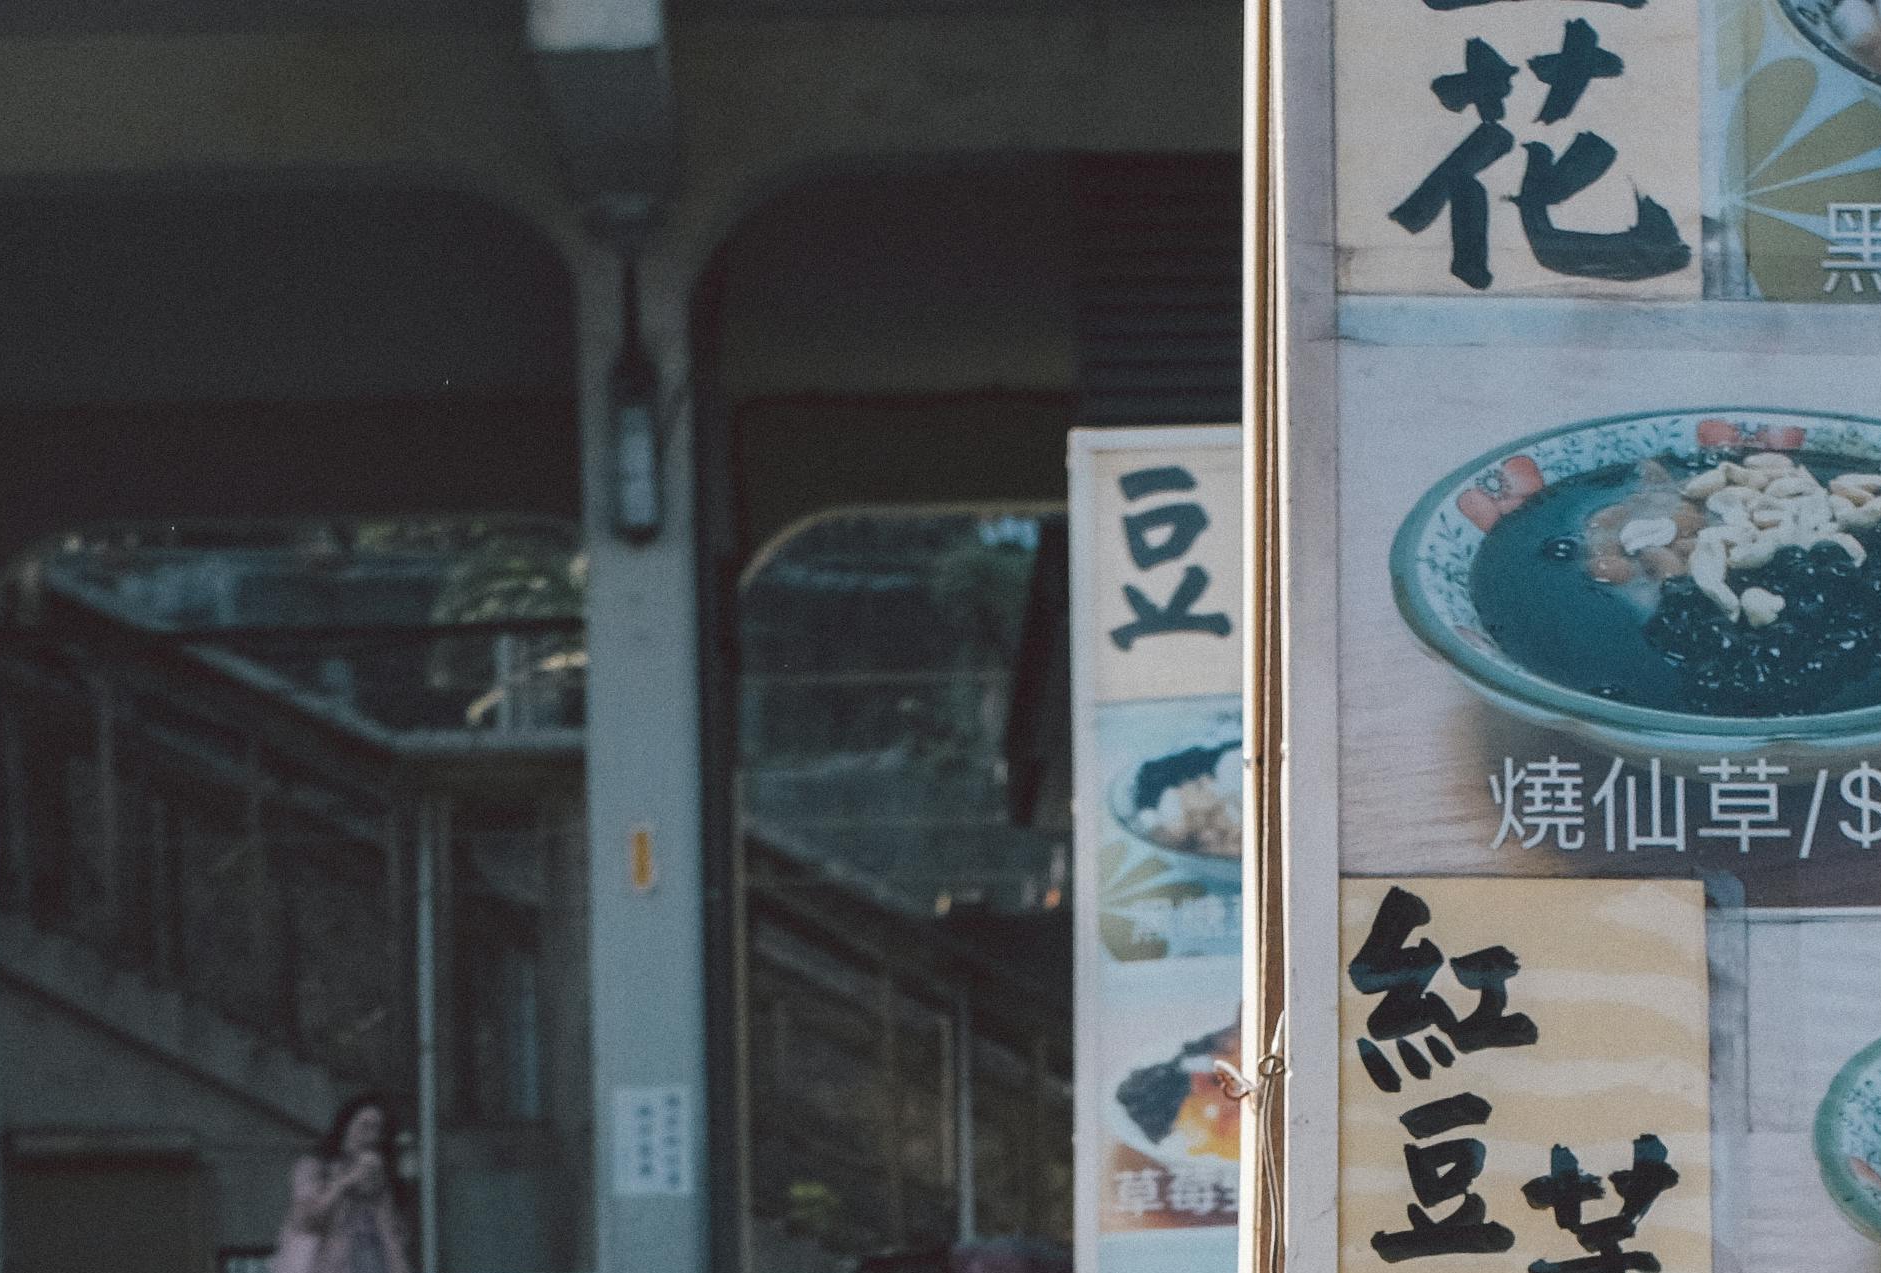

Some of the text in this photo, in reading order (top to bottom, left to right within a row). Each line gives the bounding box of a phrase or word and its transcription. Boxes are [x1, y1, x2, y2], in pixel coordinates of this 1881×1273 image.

[1386, 0, 1693, 290] 花
[1109, 464, 1234, 652] 豆
[1346, 884, 1541, 1264] 紅豆
